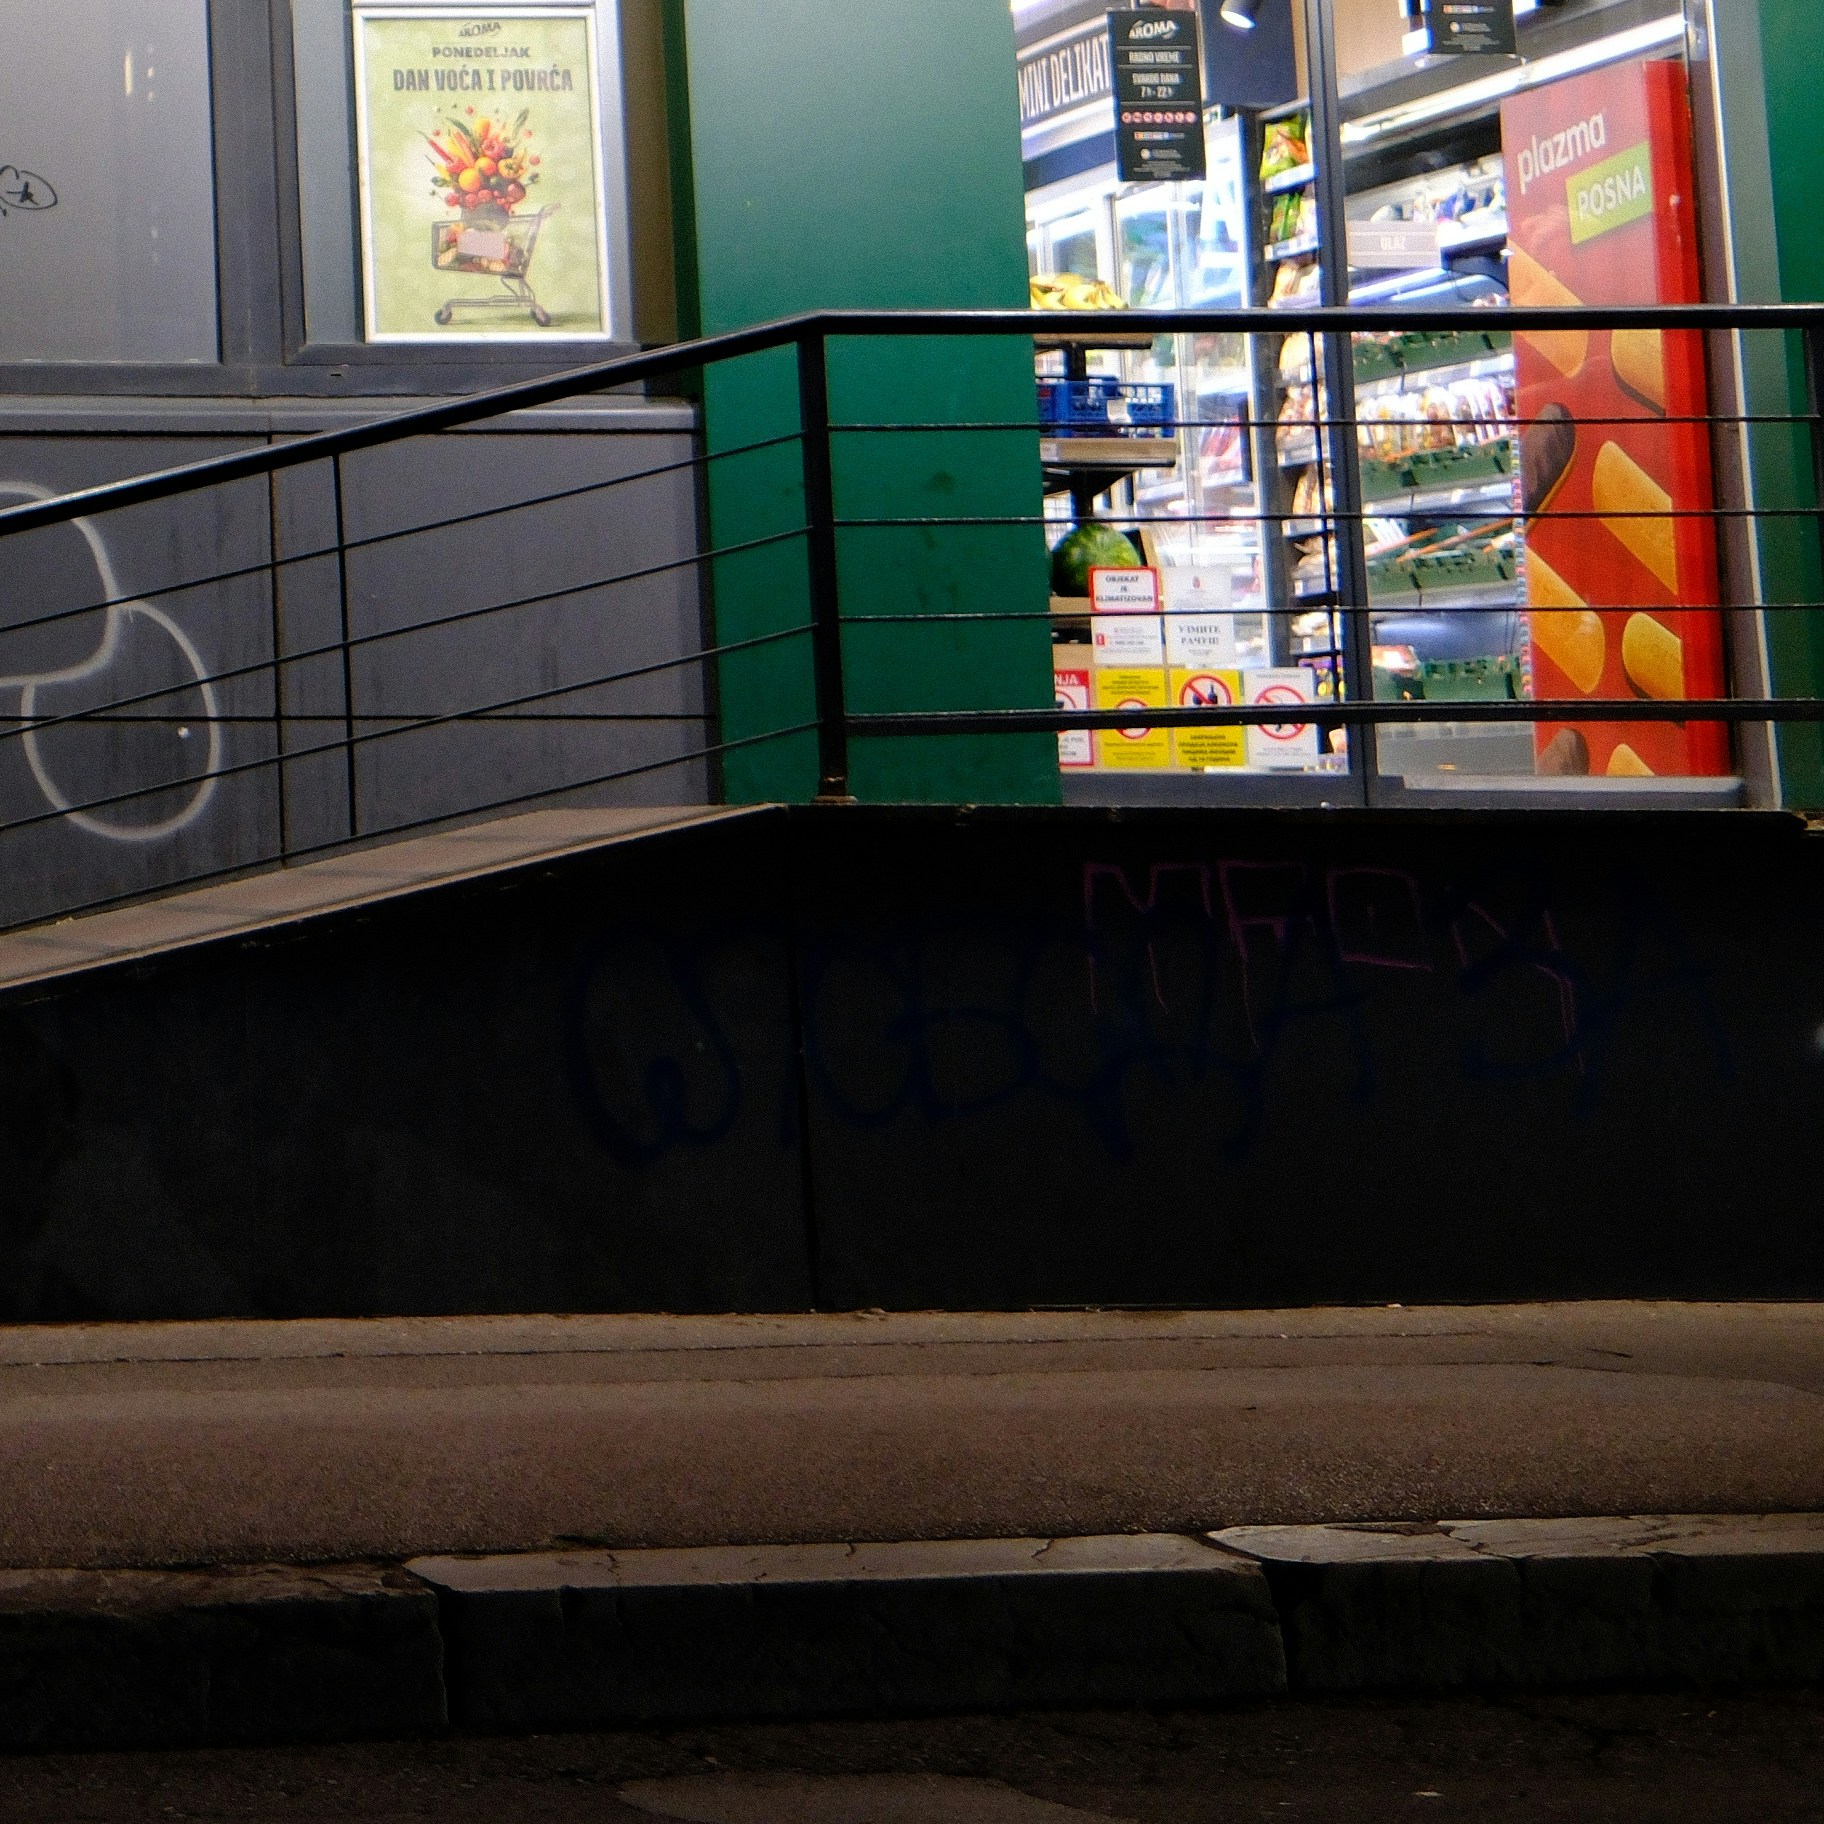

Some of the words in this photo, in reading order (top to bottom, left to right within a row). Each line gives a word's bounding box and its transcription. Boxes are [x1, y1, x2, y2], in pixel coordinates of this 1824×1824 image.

[458, 22, 501, 37] AROMA
[1128, 19, 1177, 39] AROMA
[432, 47, 530, 58] PONEDELJAK
[393, 69, 429, 91] DAN
[435, 64, 483, 91] VOĆA
[487, 69, 496, 91] I
[501, 64, 573, 91] POVRĆA
[1018, 57, 1050, 121] MINI
[1517, 113, 1606, 194] plazma
[1577, 166, 1646, 220] POSNA
[1105, 575, 1139, 583] OBJEKAT
